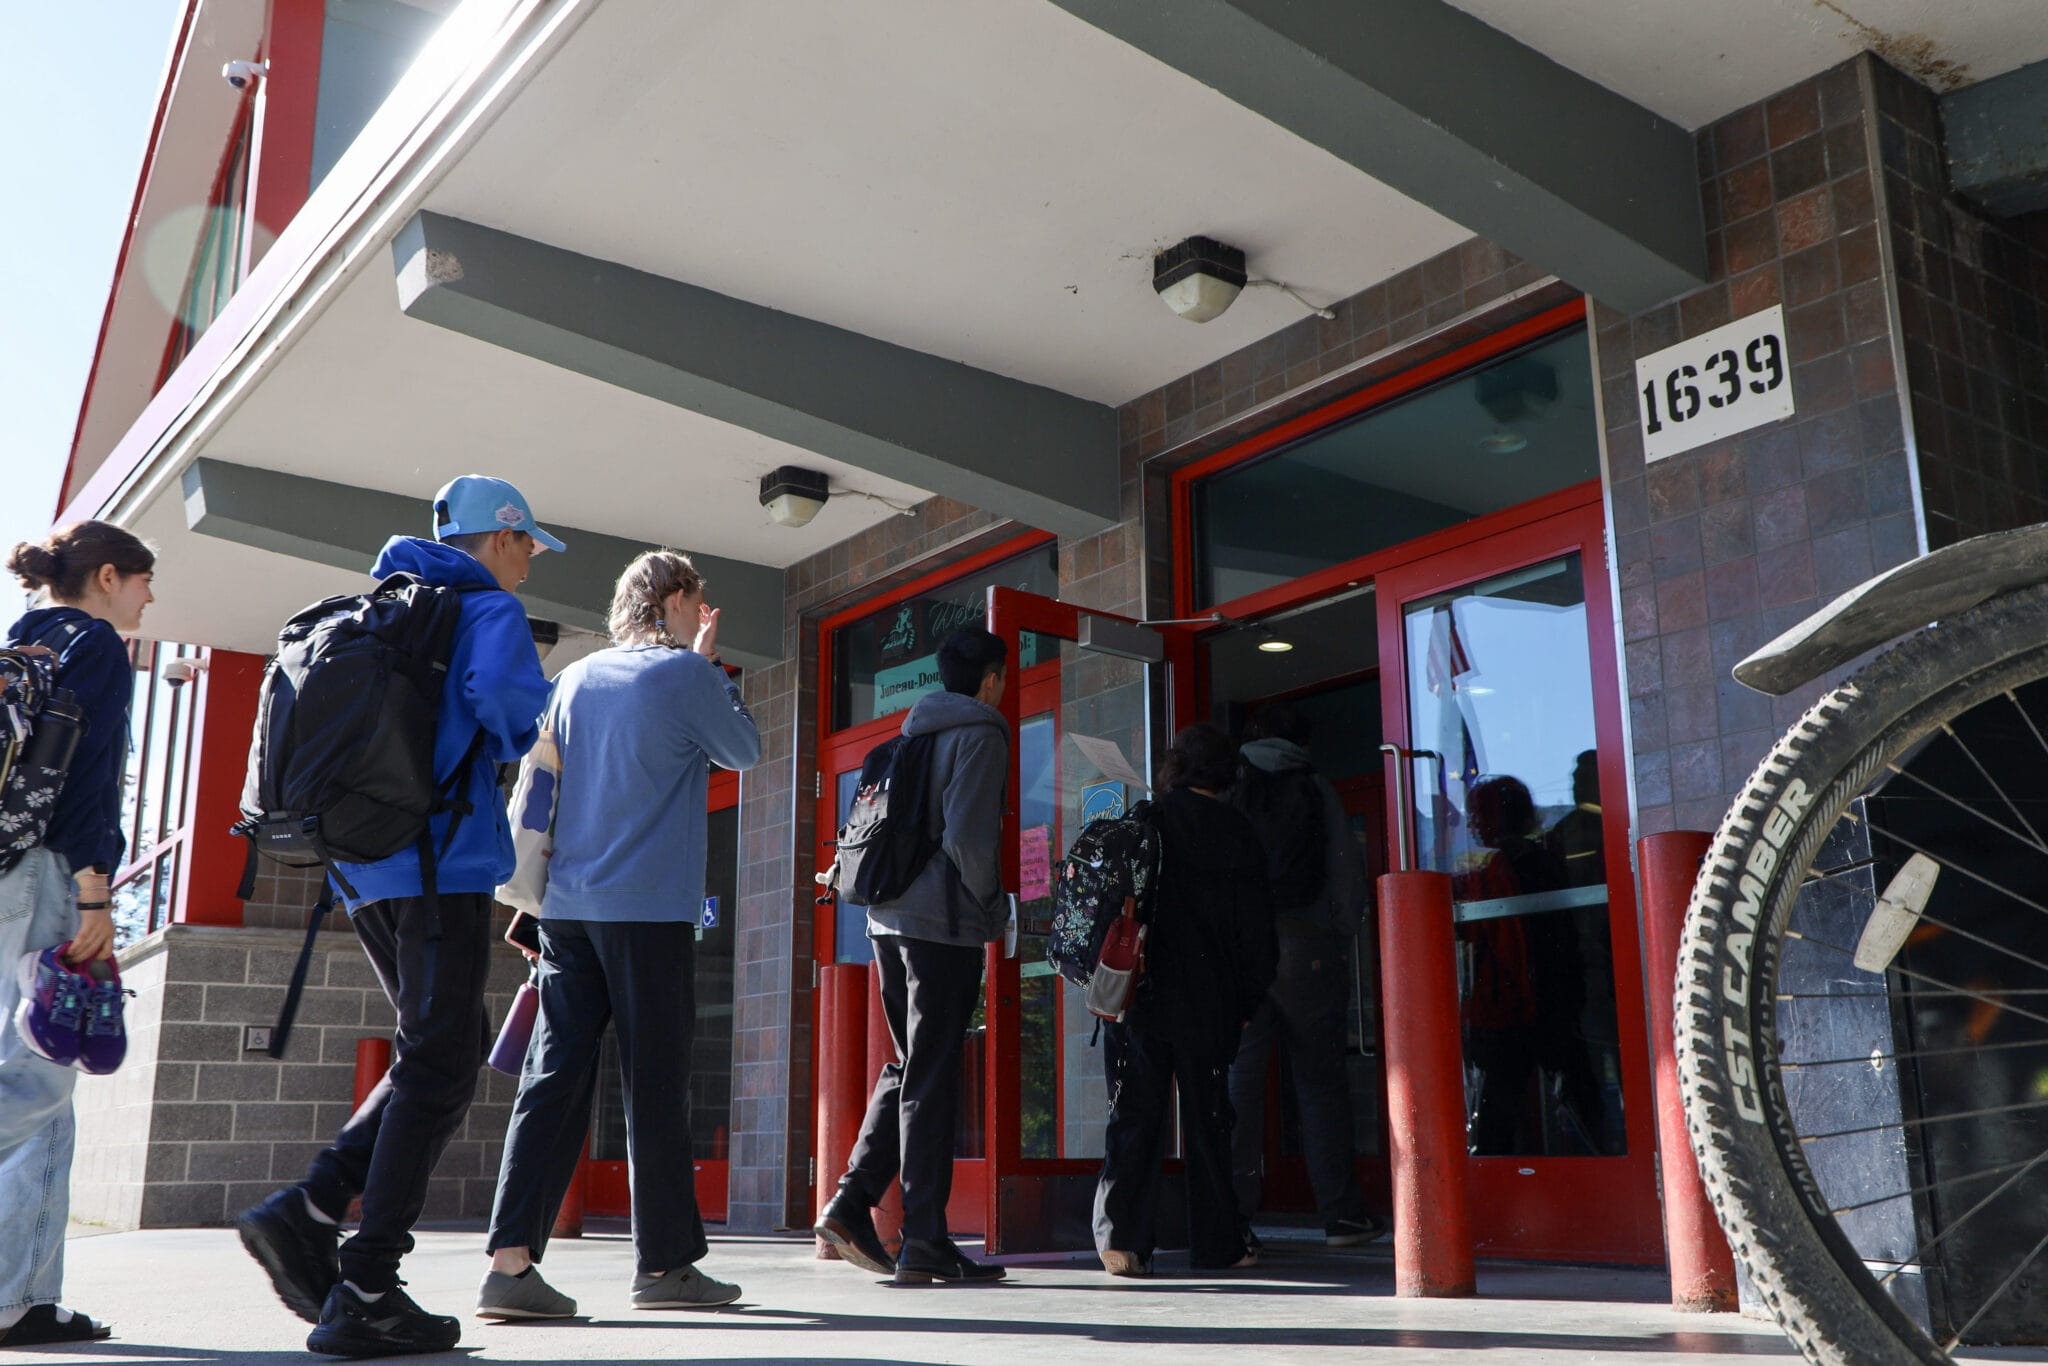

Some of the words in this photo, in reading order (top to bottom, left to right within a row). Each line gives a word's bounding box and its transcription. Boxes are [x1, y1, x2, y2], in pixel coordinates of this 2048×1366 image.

[1643, 334, 1783, 434] 1639
[880, 671, 944, 699] Juneau-Doug
[1722, 777, 1814, 1008] CAMBER
[1722, 1016, 1765, 1125] CST
